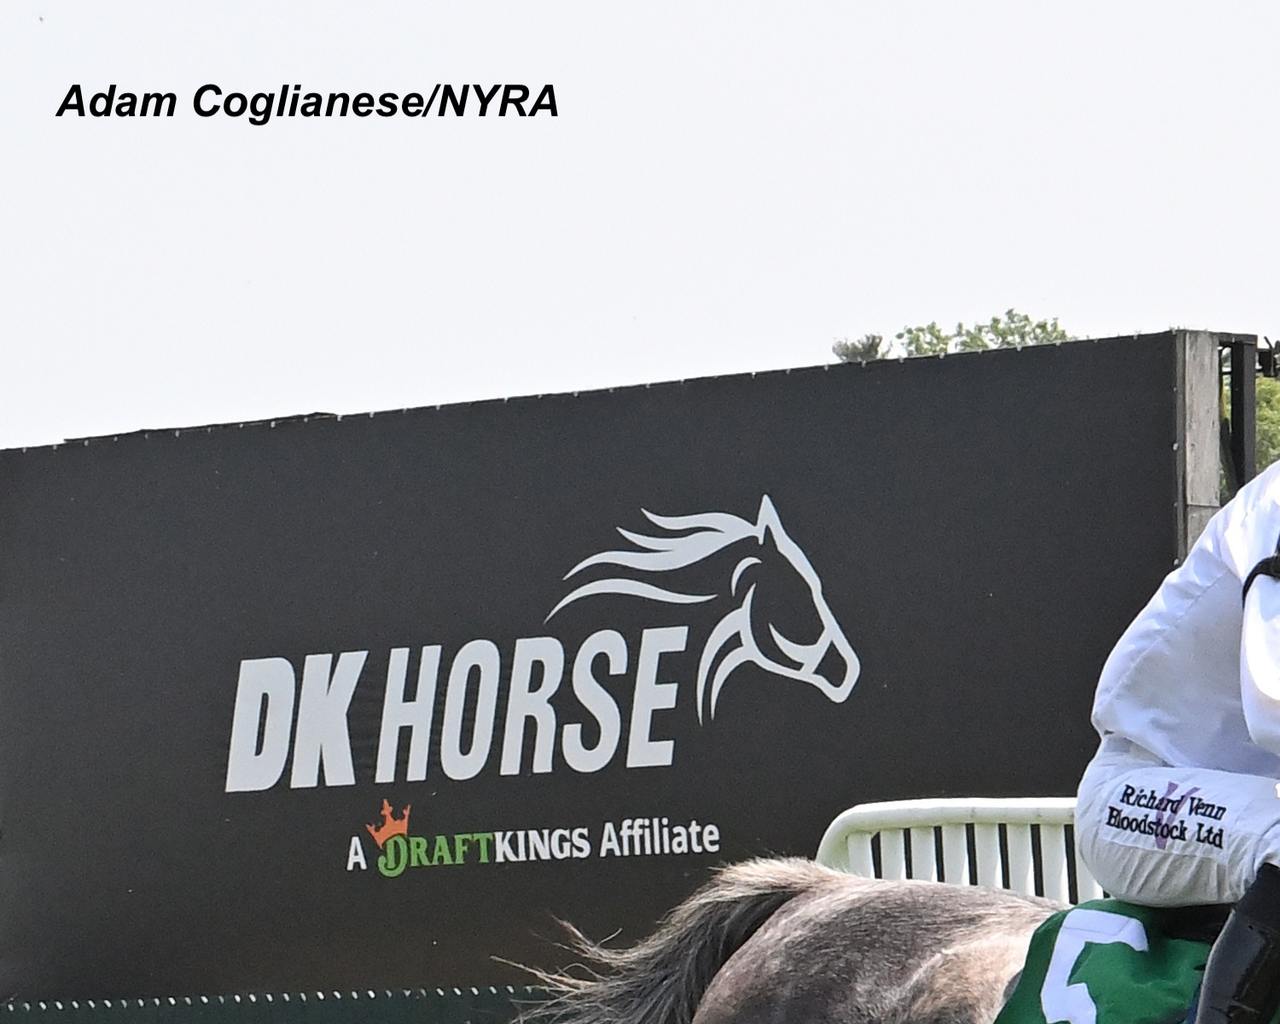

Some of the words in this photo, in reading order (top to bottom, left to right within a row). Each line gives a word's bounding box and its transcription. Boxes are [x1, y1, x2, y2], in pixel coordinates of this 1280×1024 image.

[225, 650, 368, 793] DK
[374, 626, 689, 784] HORSE
[1106, 806, 1187, 842] Bloodstock
[1196, 822, 1224, 849] Ltd
[1119, 784, 1186, 814] Richard
[1187, 796, 1226, 821] Venn
[346, 836, 367, 871] A
[377, 827, 592, 877] DRAFTKINGS
[600, 817, 720, 857] Affiliate
